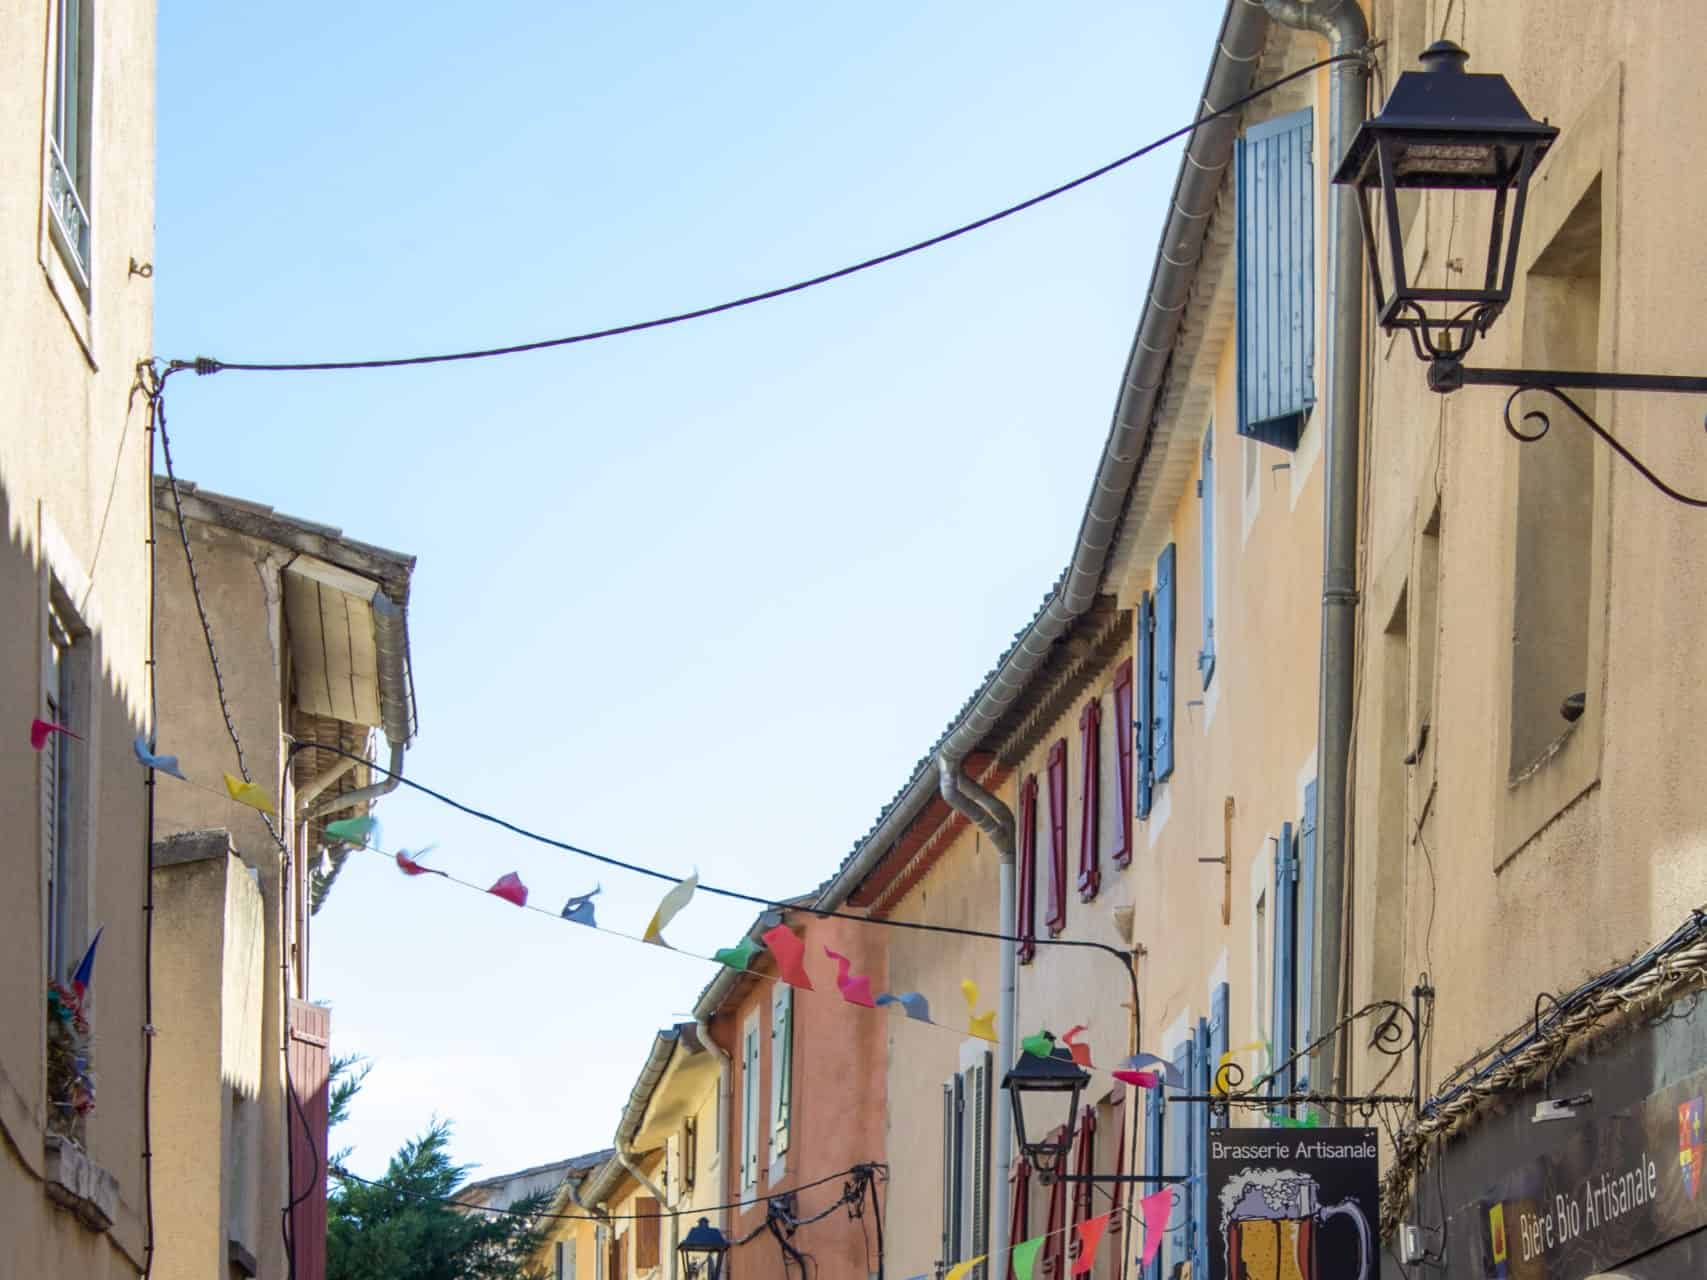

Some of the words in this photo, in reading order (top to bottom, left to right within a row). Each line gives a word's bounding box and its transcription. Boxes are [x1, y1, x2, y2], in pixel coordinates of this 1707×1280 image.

[1211, 1141, 1290, 1160] Brasserie
[1295, 1141, 1377, 1160] Artisanale
[1520, 1213, 1553, 1262] Bière
[1556, 1194, 1580, 1244] Bio
[1586, 1152, 1656, 1232] Artisanale
